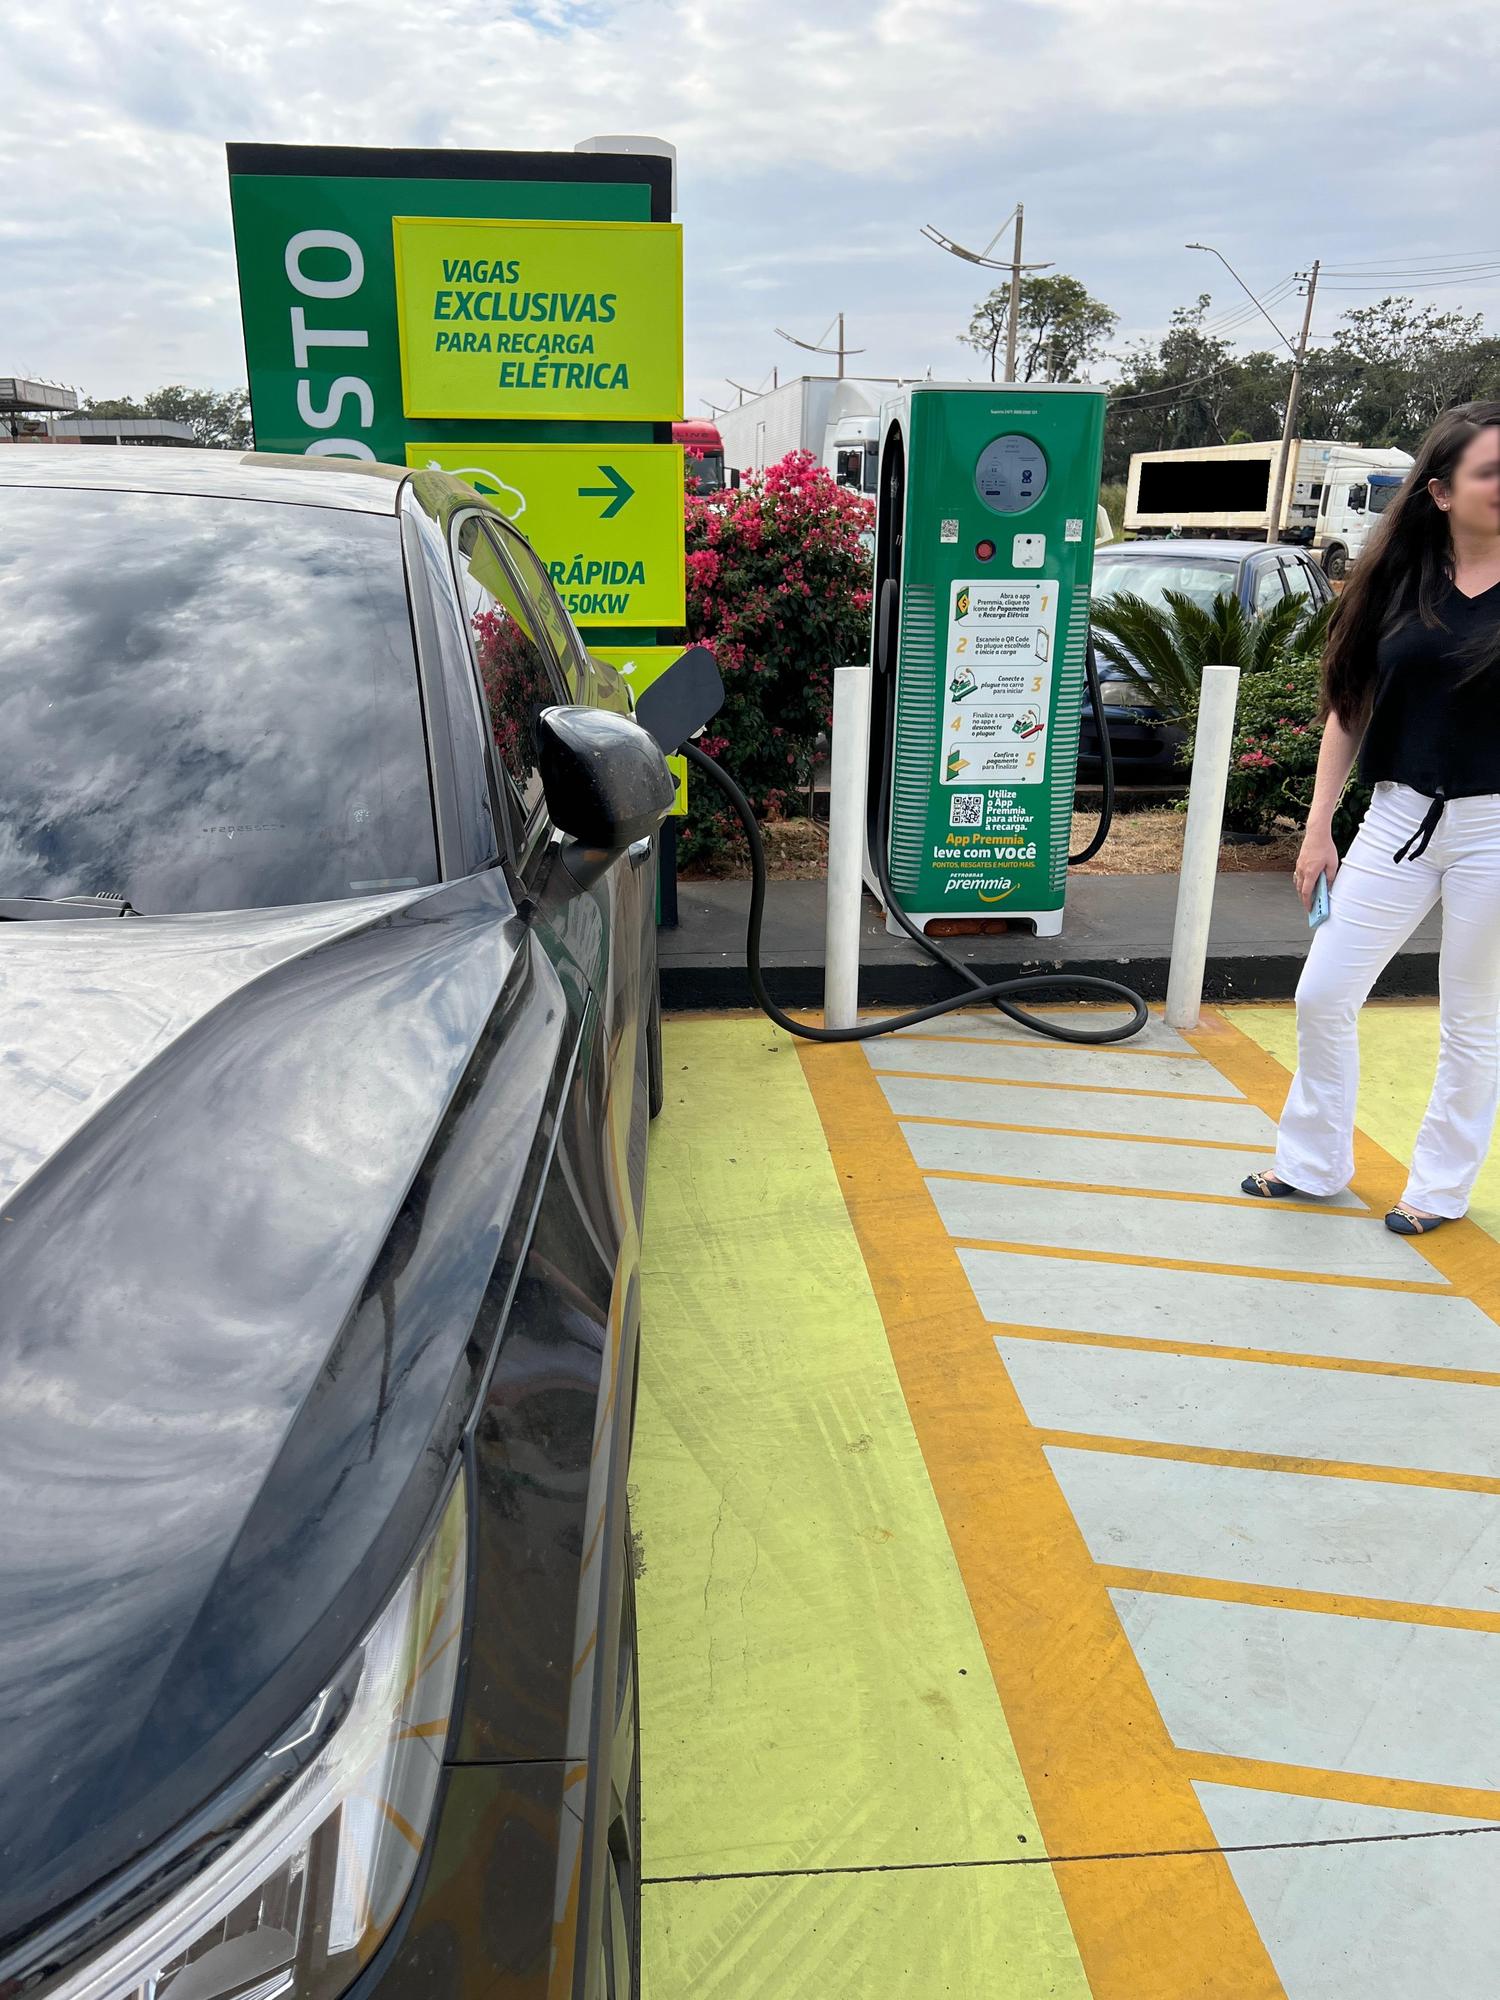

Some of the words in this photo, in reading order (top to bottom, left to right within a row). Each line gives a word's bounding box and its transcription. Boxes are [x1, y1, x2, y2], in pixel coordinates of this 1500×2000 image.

[442, 259, 520, 283] VAGAS
[434, 291, 617, 323] EXCLUSIVAS
[435, 332, 492, 353] PARA
[497, 334, 595, 354] RECARGA
[499, 354, 630, 390] ELÉTRICA
[542, 553, 646, 585] RÁPIDA
[997, 605, 1029, 613] Pagamento
[1005, 599, 1021, 607] clique
[1040, 596, 1049, 612] 1
[956, 637, 968, 653] 2
[1031, 677, 1042, 691] 3
[951, 717, 962, 731] 4
[976, 730, 996, 738] plugue
[1025, 752, 1036, 767] 5
[988, 789, 1017, 799] Utilize
[986, 805, 1026, 815] Premmia
[994, 798, 1013, 809] App
[986, 816, 1006, 824] para
[1007, 814, 1034, 823] ativar
[992, 824, 1028, 833] recarga.
[945, 833, 970, 846] App
[973, 833, 1024, 845] Premmia
[933, 846, 961, 858] leve
[963, 849, 992, 858] com
[932, 861, 960, 869] PONTOS,
[944, 876, 1012, 894] premmia
